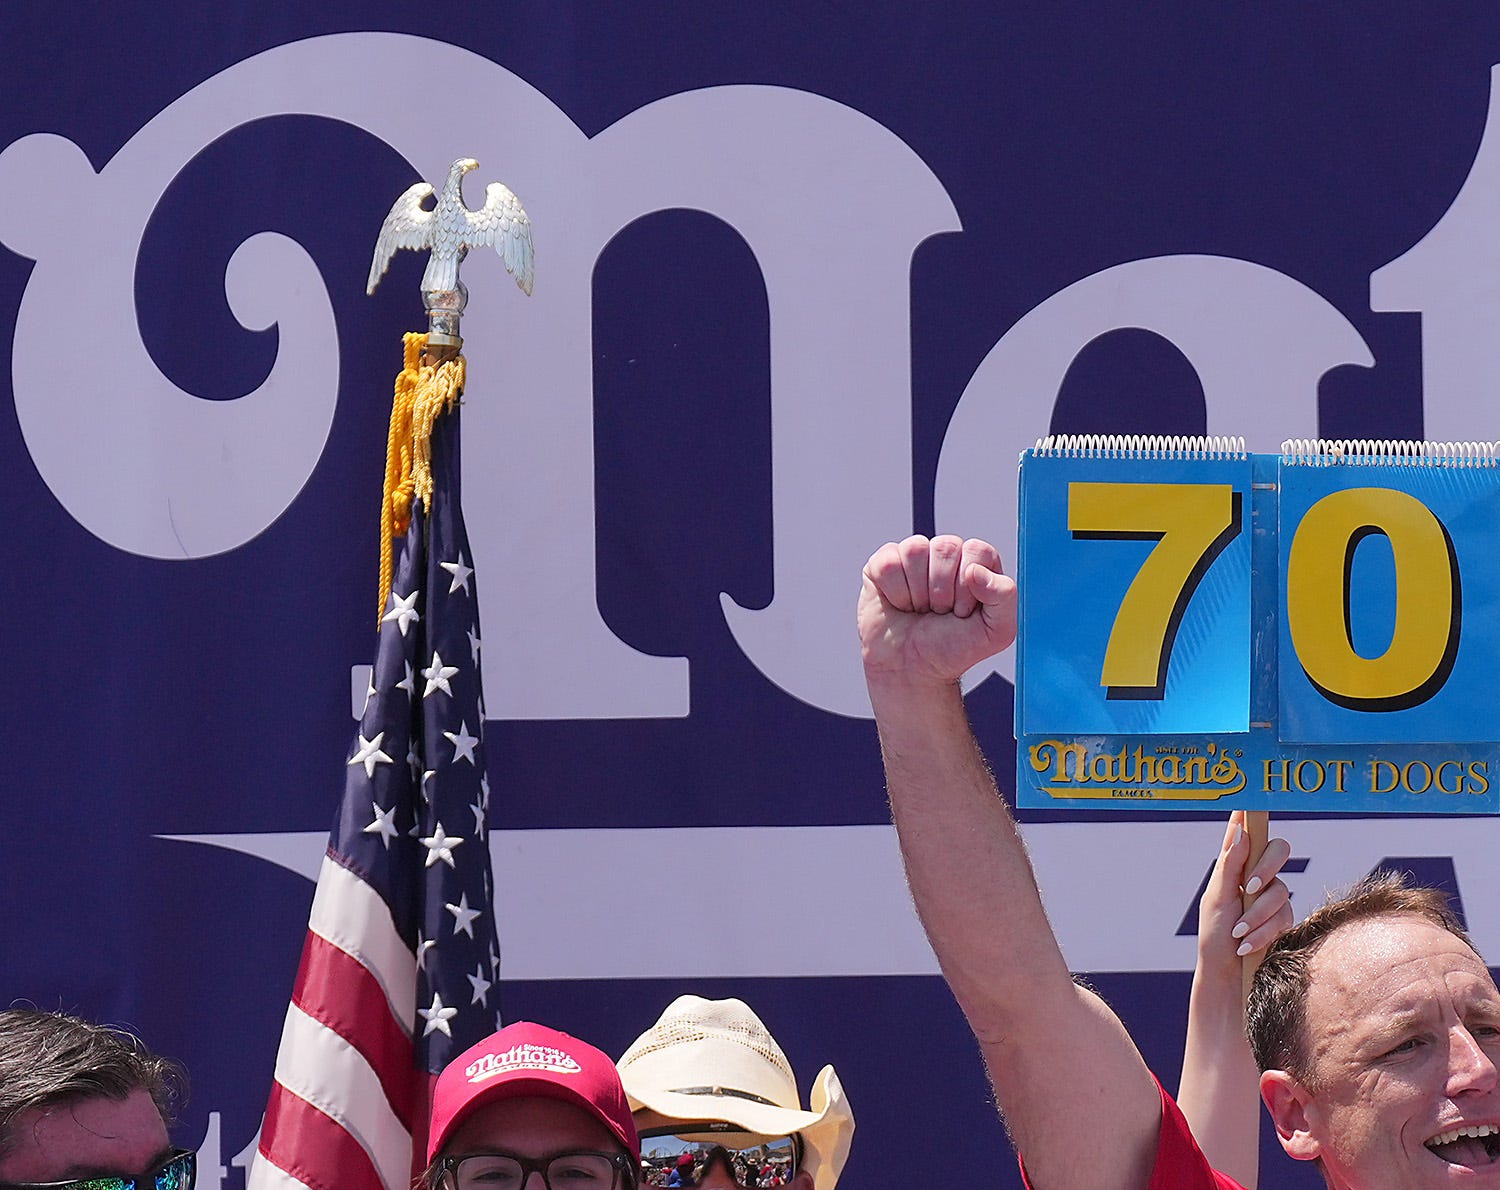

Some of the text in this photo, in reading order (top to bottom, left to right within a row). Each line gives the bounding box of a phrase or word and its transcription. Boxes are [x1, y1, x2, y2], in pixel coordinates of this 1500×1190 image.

[1029, 740, 1490, 796] Nathan's HOT DOGS
